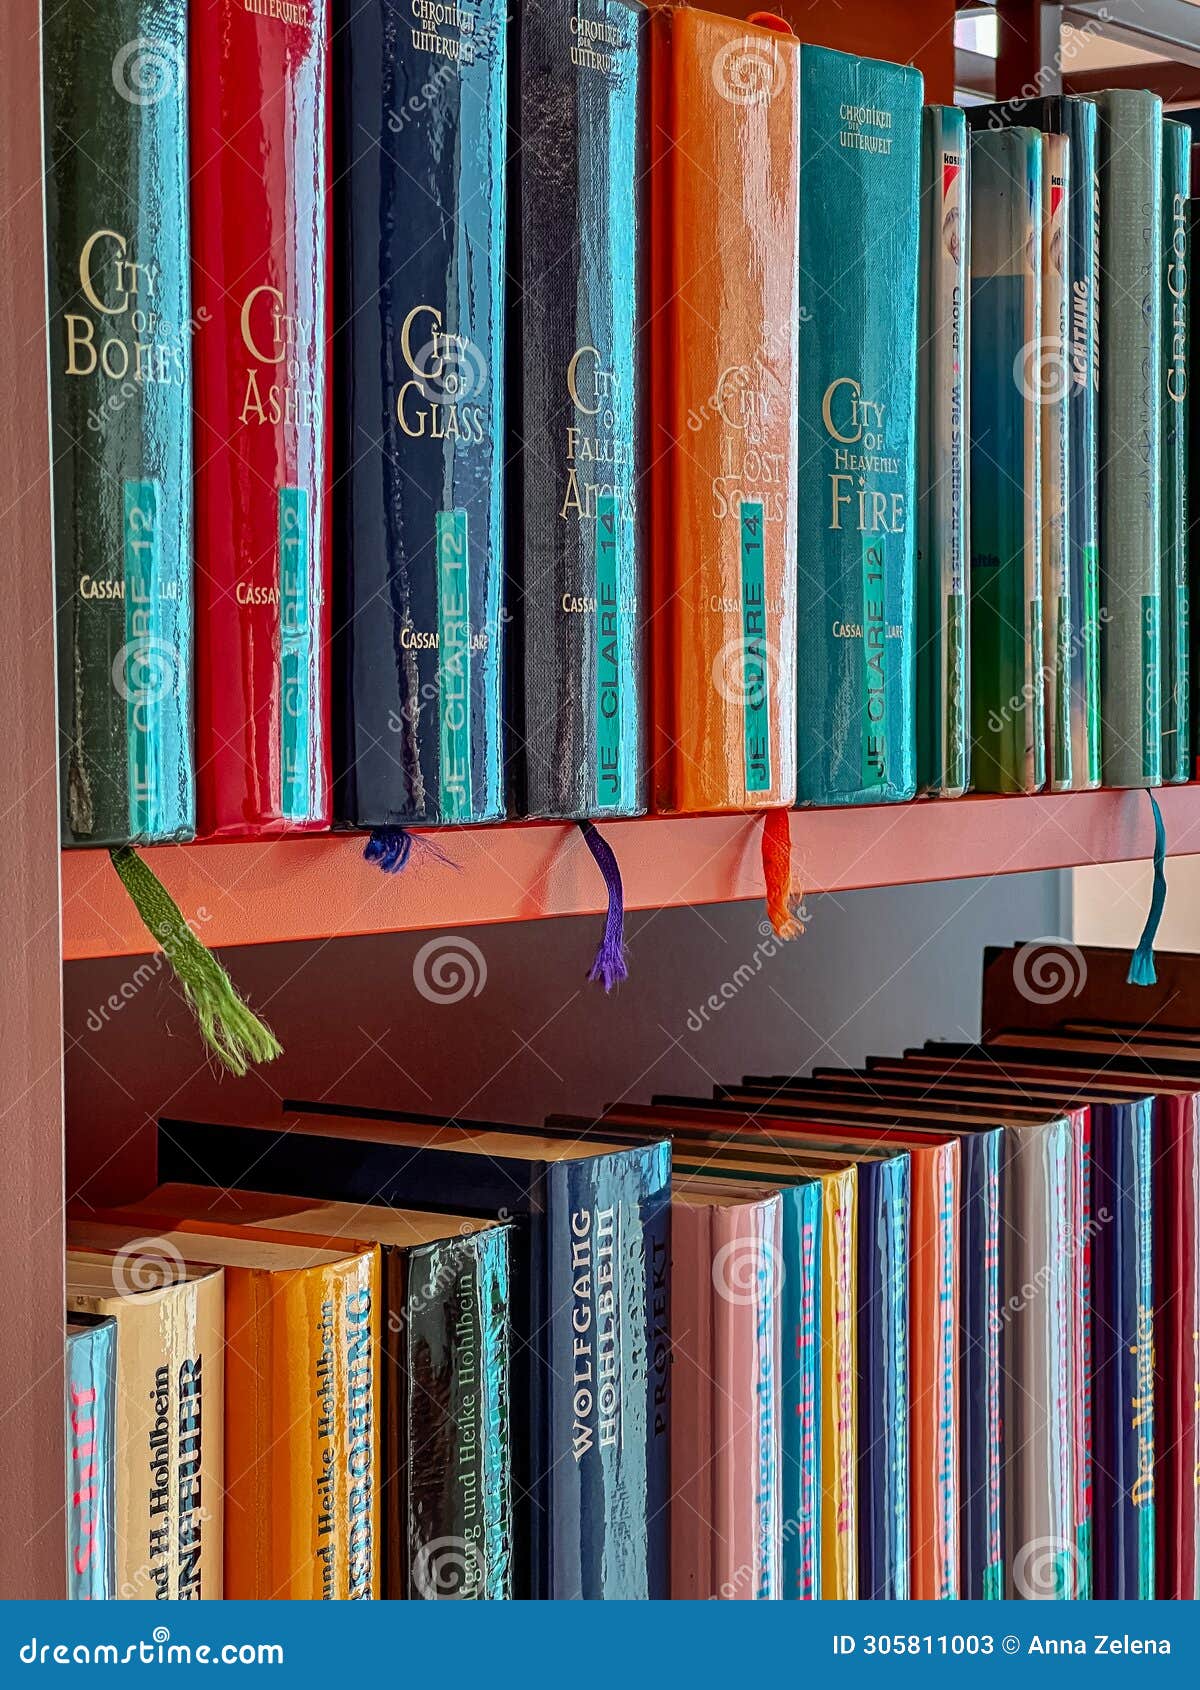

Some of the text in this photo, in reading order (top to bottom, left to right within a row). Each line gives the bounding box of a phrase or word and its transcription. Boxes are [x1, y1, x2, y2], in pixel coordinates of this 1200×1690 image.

[840, 103, 892, 129] CHRONIKEN
[840, 131, 893, 155] UNTERWELT
[79, 230, 160, 315] CITY
[1167, 192, 1189, 403] GREGOR
[63, 314, 185, 386] BONES
[240, 285, 312, 363] CITY
[401, 305, 470, 378] CITY
[397, 380, 484, 442] GLASS
[445, 372, 468, 395] OF
[821, 377, 886, 444] CITY
[725, 436, 785, 483] LOST
[835, 449, 900, 474] HEAVENLY
[864, 432, 884, 450] OF
[828, 473, 905, 533] FIRE
[441, 532, 464, 574] 12
[600, 514, 619, 794] JE CLARE 14
[743, 514, 767, 782] JE CLARE 14
[867, 547, 885, 778] JE CLARE 12
[456, 1274, 476, 1389] Hohlbein
[571, 1206, 594, 1463] WOLFGANG
[598, 1207, 622, 1449] HOHLBEIN
[315, 1300, 336, 1440] Hohlbein
[1131, 1305, 1157, 1506] Der Magier
[458, 1394, 477, 1465] Heike
[316, 1447, 337, 1537] Heike
[457, 1469, 478, 1520] und
